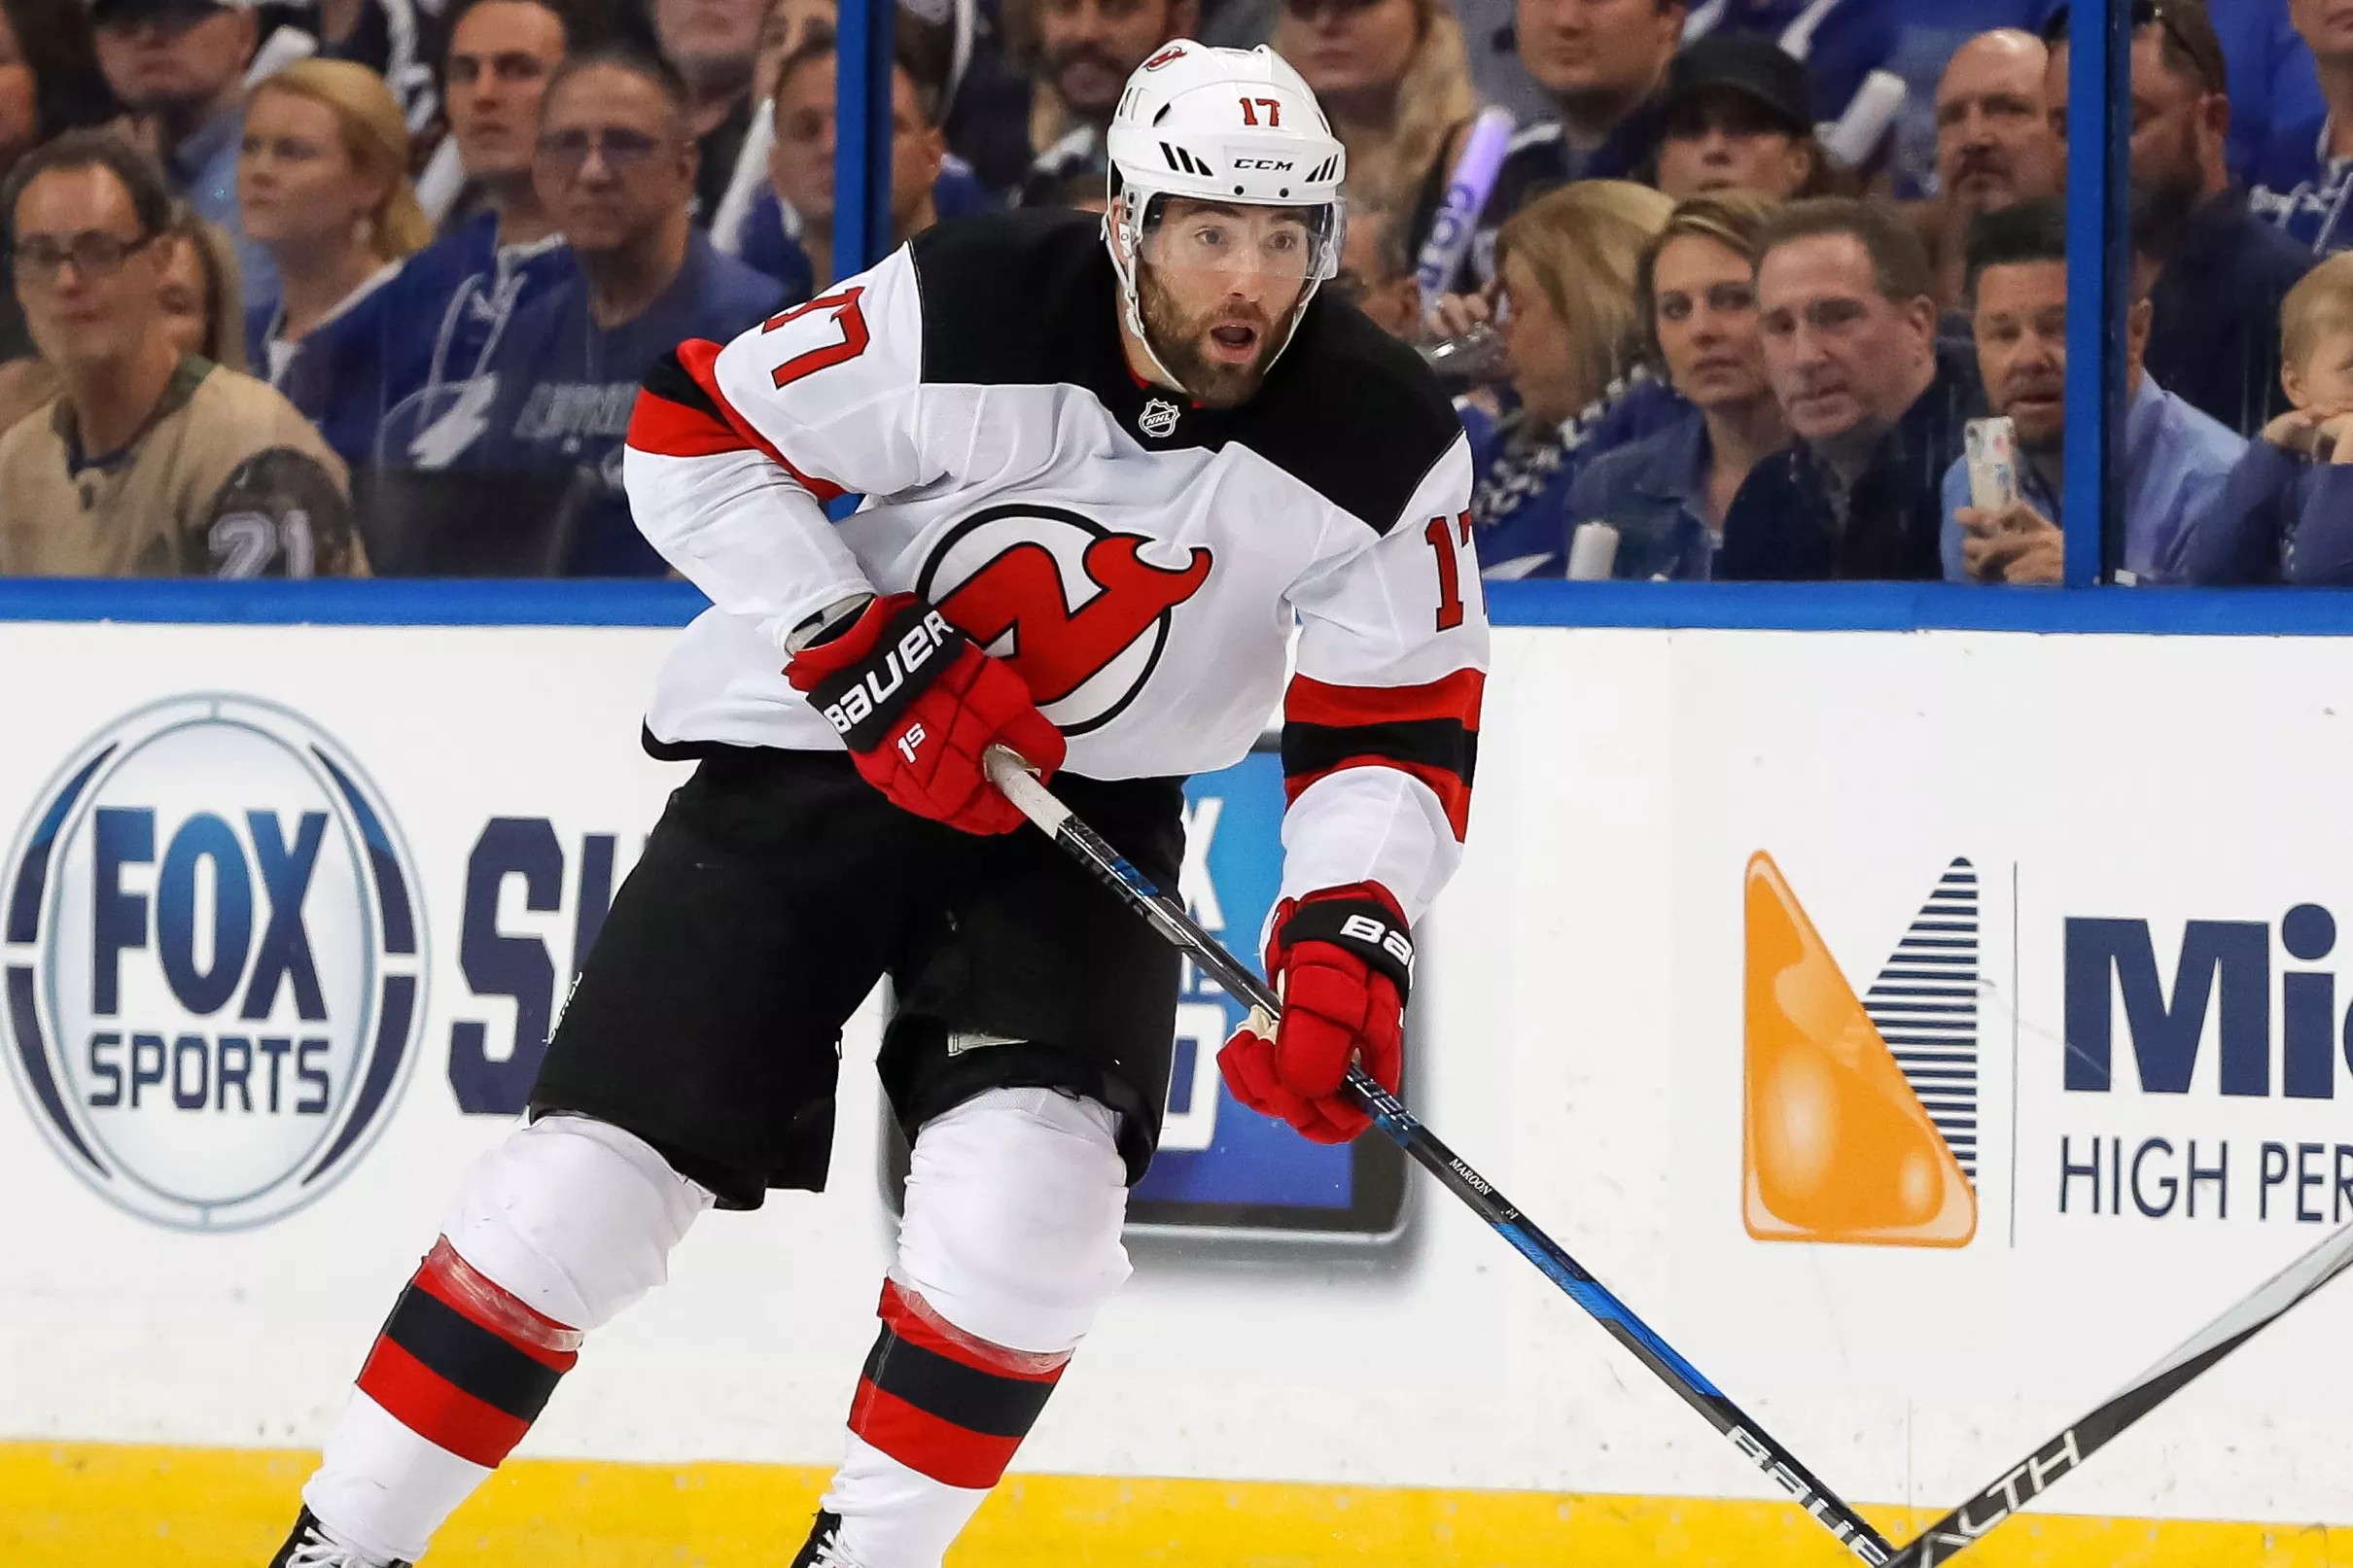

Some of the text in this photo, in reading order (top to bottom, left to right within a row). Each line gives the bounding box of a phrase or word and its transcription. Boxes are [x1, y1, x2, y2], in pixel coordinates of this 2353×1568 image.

[1239, 97, 1281, 127] 17
[1234, 158, 1294, 171] CCM
[761, 286, 870, 390] 17
[208, 509, 316, 580] 21
[94, 805, 331, 1021] FOX
[2063, 902, 2353, 1099] Mi
[88, 1031, 331, 1115] SPORTS
[1449, 1158, 1493, 1197] MAROON
[2058, 1134, 2229, 1220] HIGH
